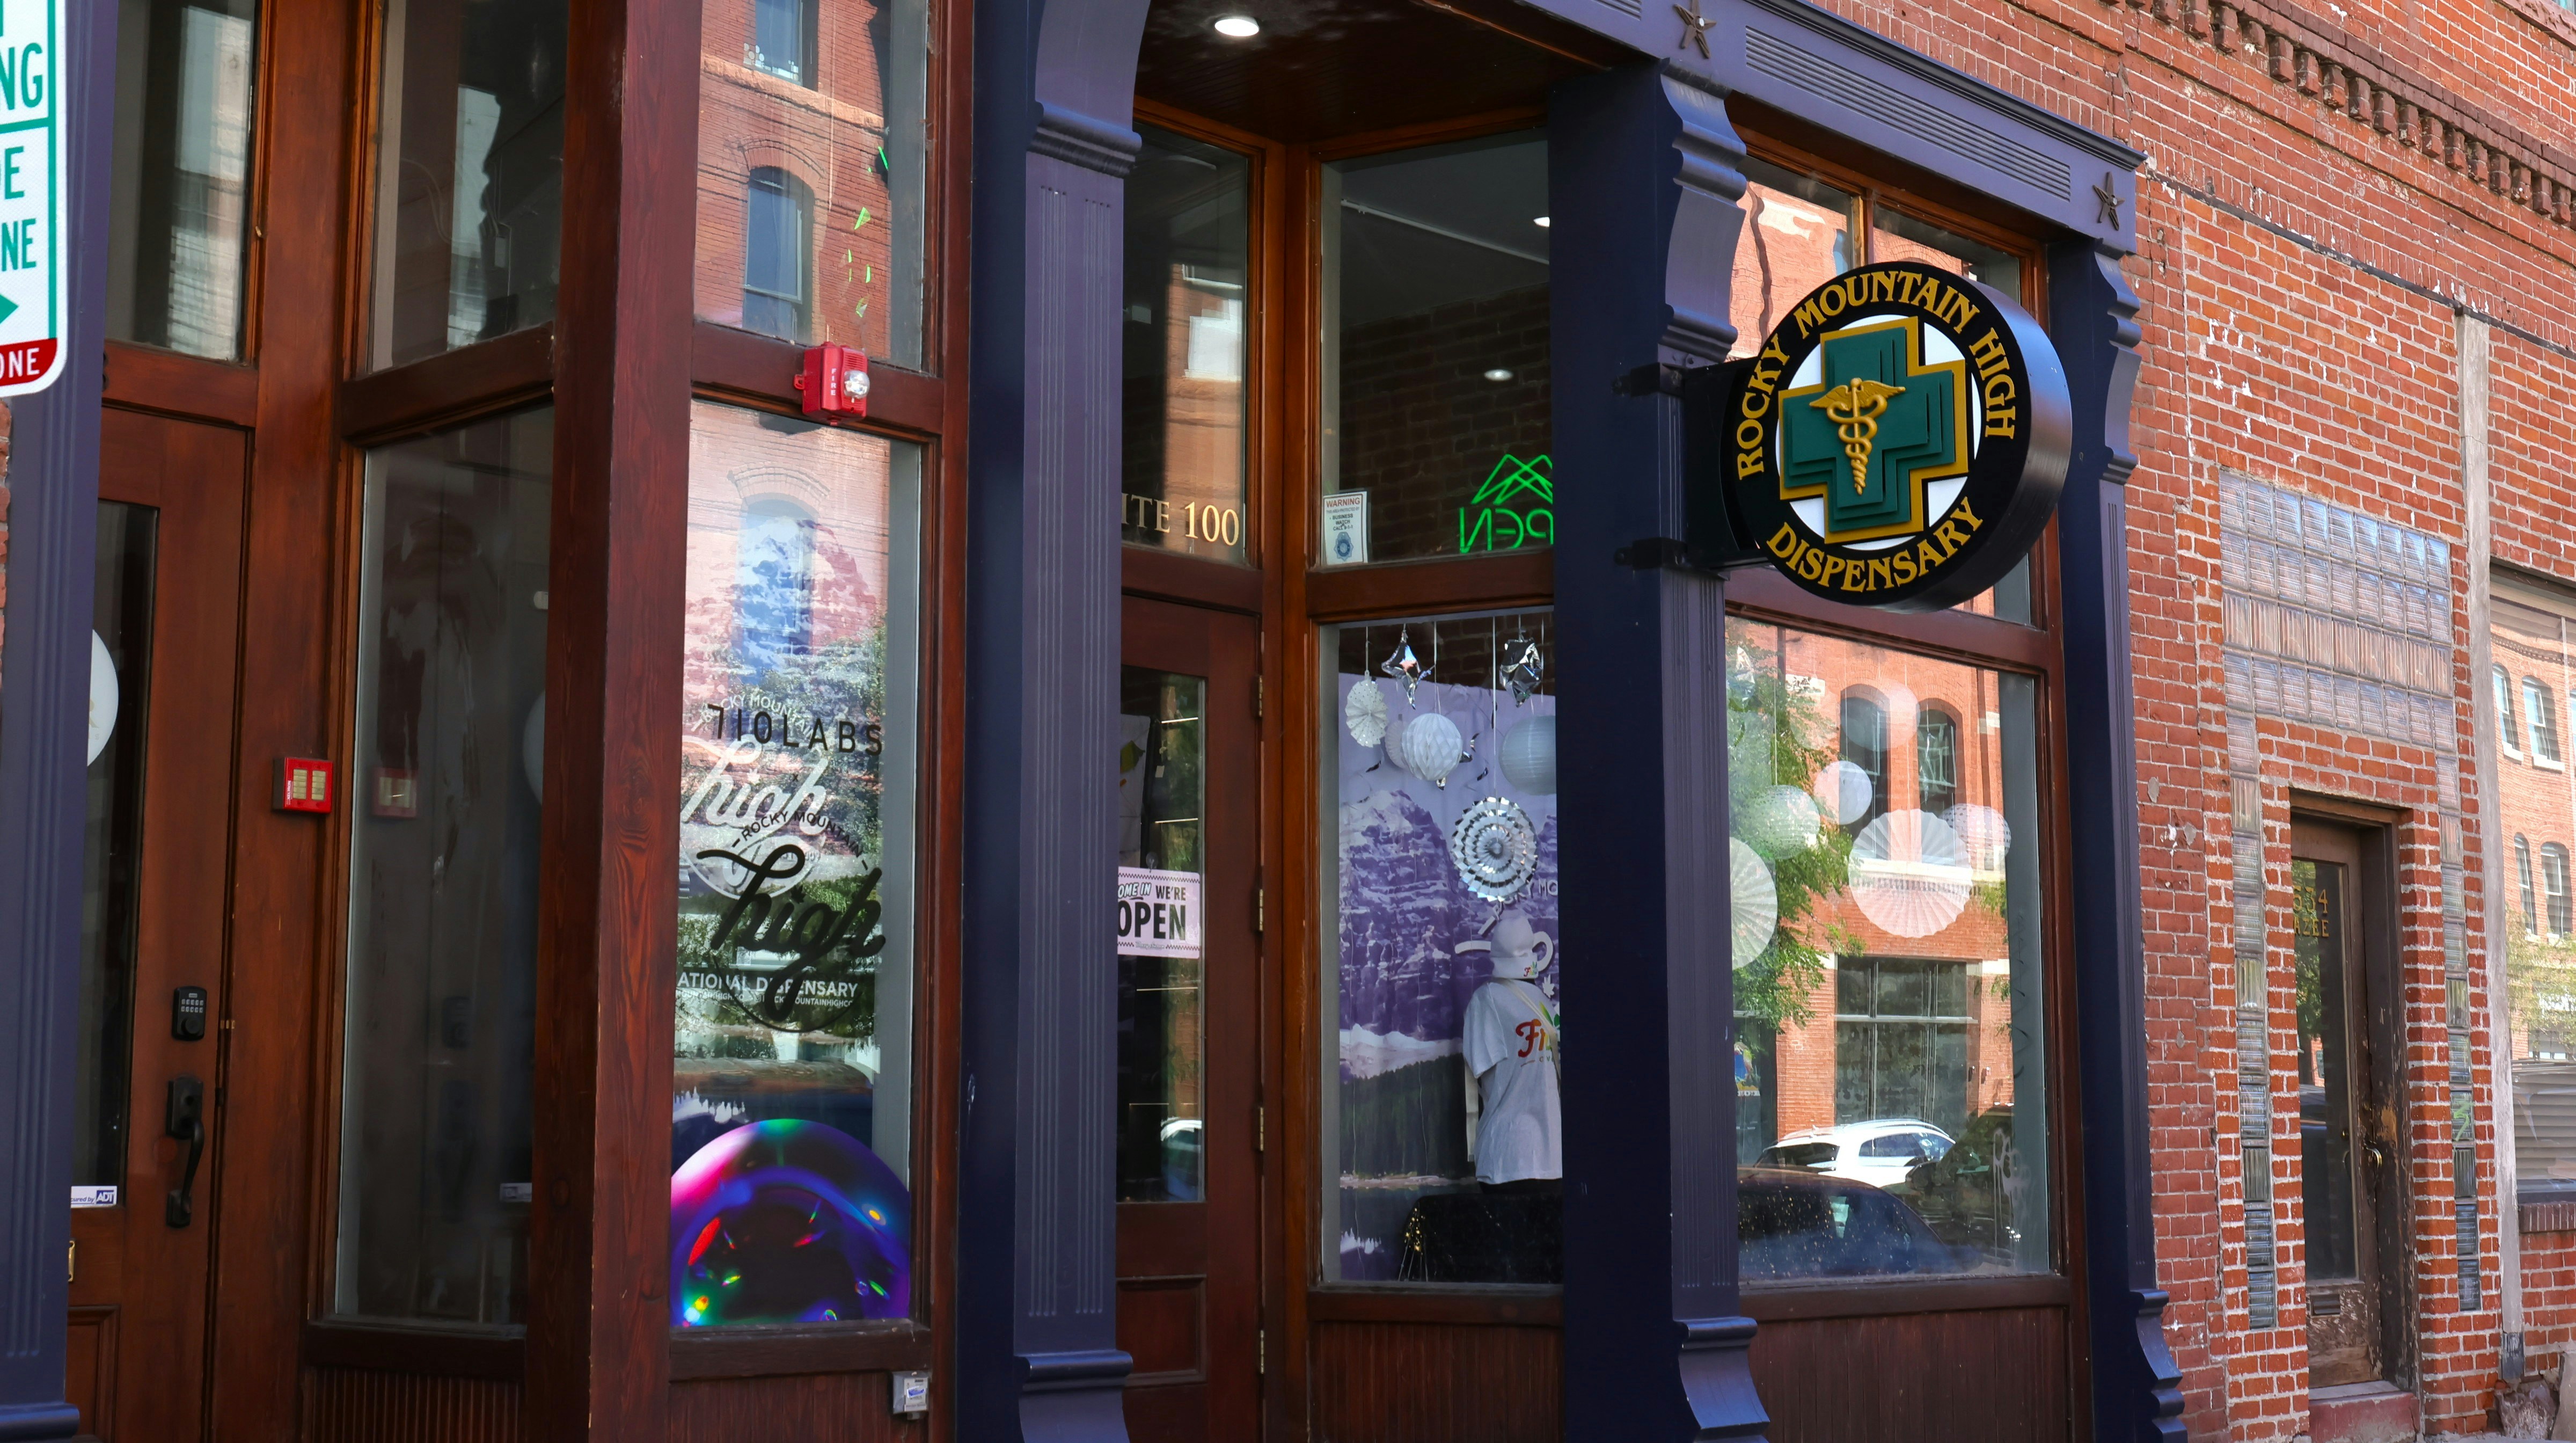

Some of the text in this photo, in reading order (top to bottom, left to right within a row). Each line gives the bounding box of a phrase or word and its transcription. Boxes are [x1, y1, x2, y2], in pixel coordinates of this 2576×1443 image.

[1737, 270, 2016, 480] ROCKY MOUNTAIN HIGH
[1184, 501, 1239, 546] 100
[1326, 497, 1360, 508] WARNING
[1767, 497, 1984, 593] DISPENSARY
[742, 811, 865, 858] ROCKY MOUNTAIN
[1140, 882, 1152, 896] IN
[1155, 885, 1186, 901] WE'RE
[696, 843, 886, 1022] high
[1117, 900, 1186, 941] OPEN
[97, 1191, 114, 1202] ADT
